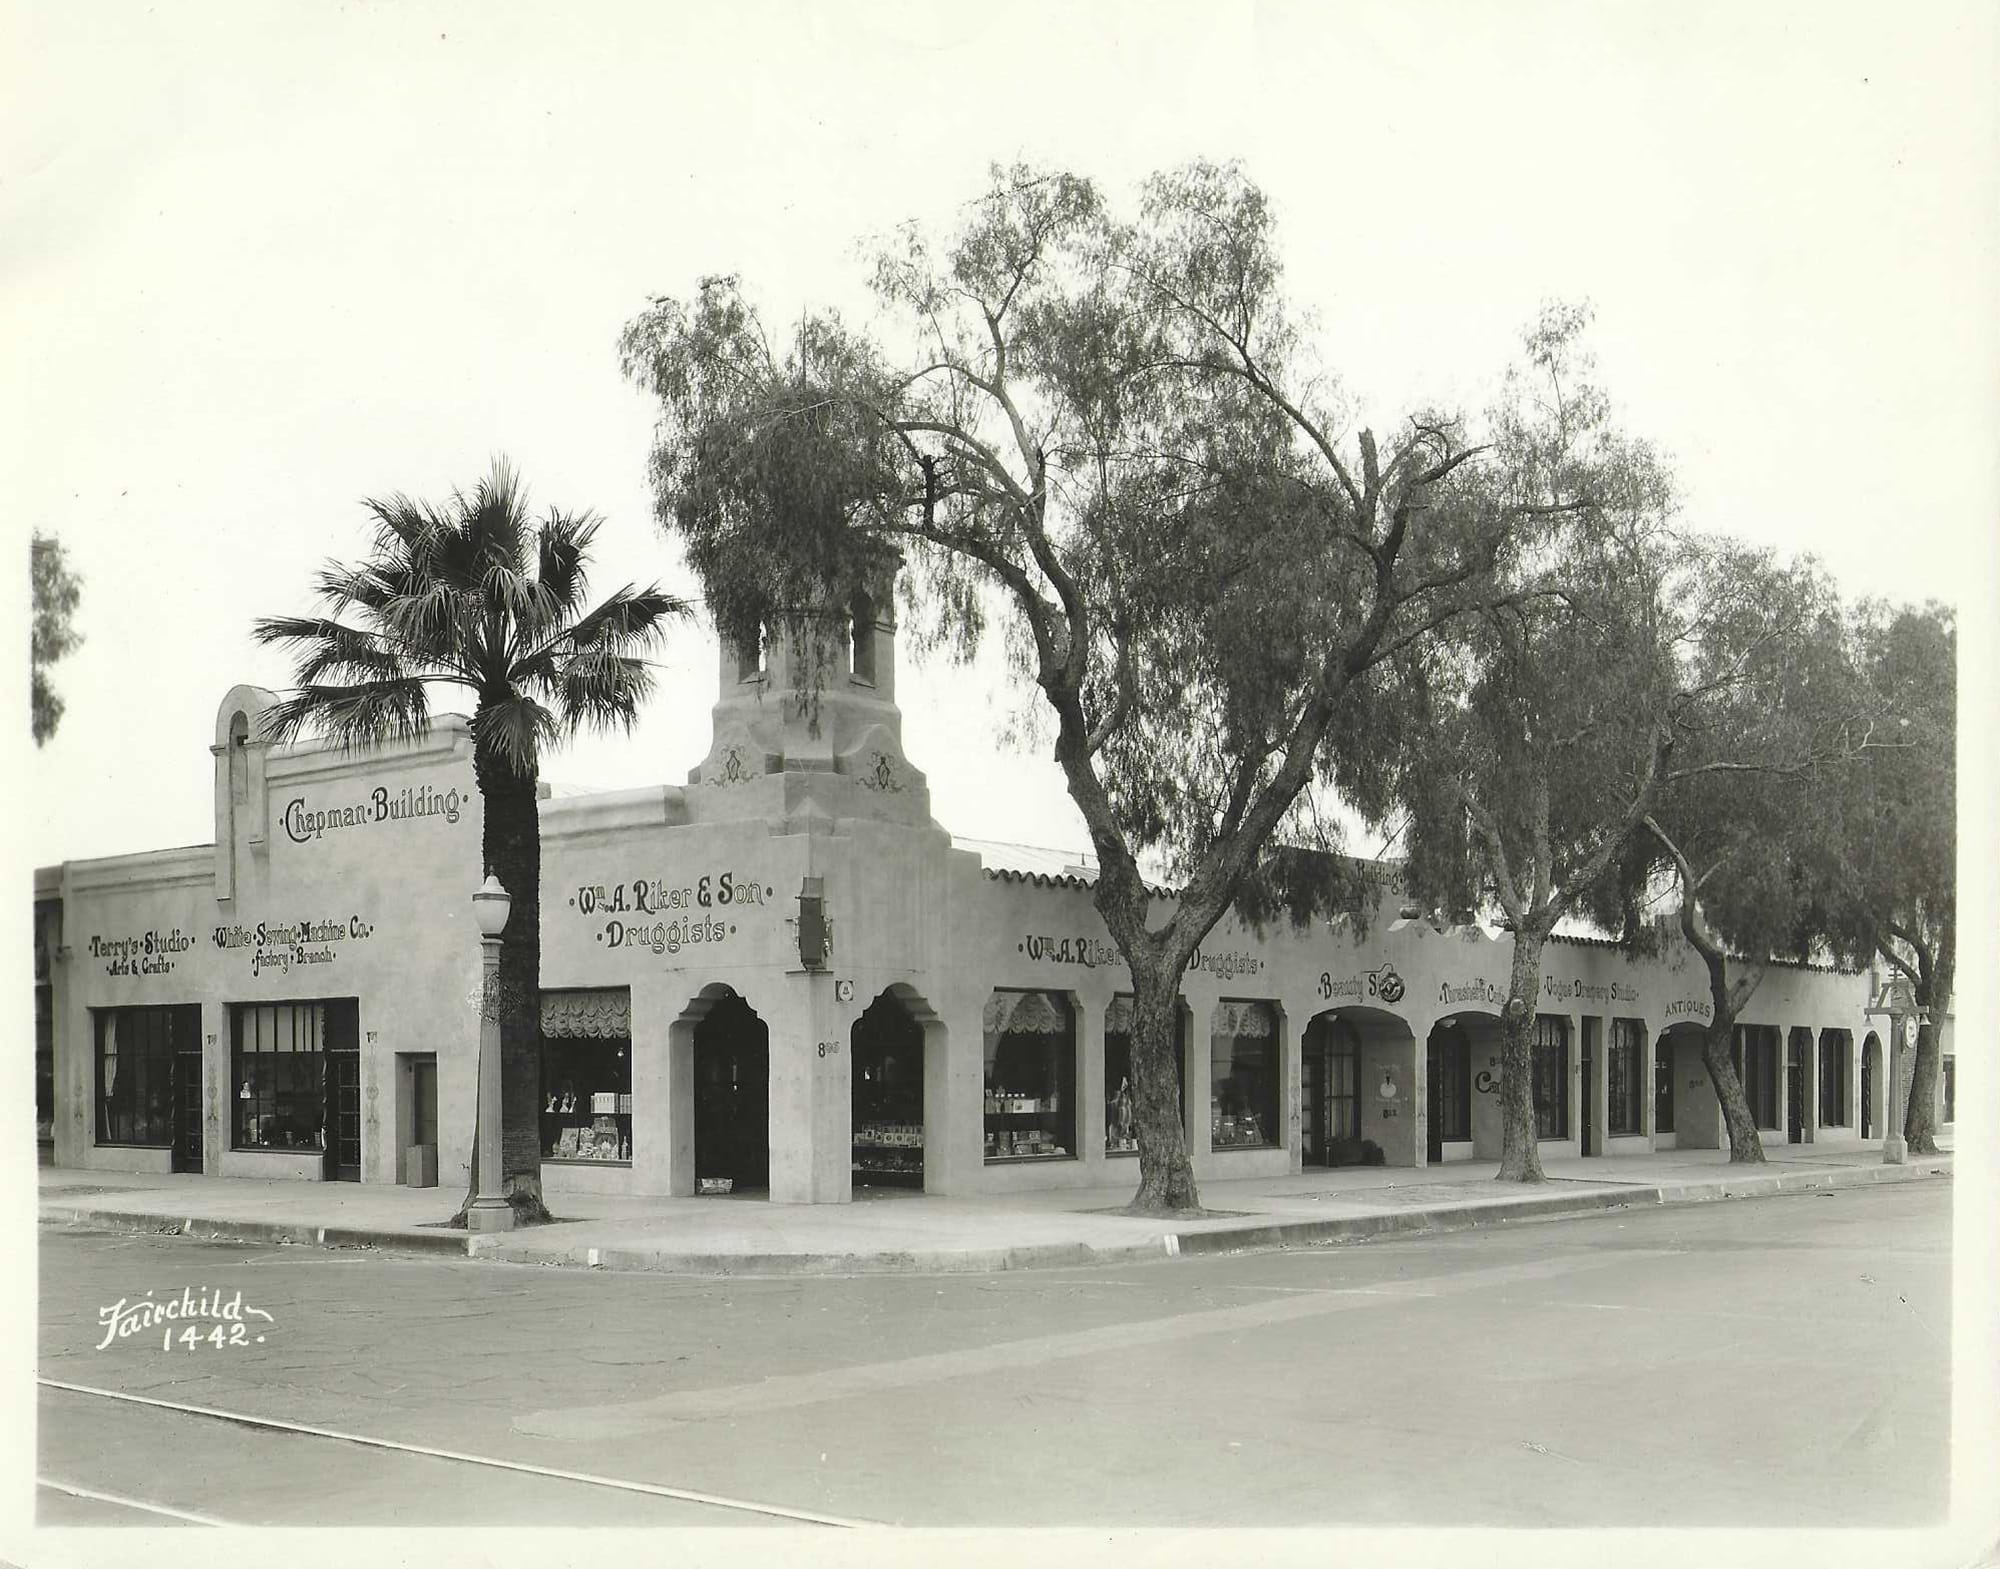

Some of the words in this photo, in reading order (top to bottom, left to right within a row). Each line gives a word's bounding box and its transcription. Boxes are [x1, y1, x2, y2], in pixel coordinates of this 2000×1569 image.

[285, 797, 367, 843] Chapman
[371, 786, 460, 823] Building
[633, 879, 692, 915] Riker
[718, 872, 765, 906] Son
[91, 935, 139, 962] Terry's
[144, 928, 189, 955] Studio
[606, 915, 726, 954] Druggists
[141, 954, 171, 975] Crafts
[1664, 999, 1712, 1018] ANTIQUES
